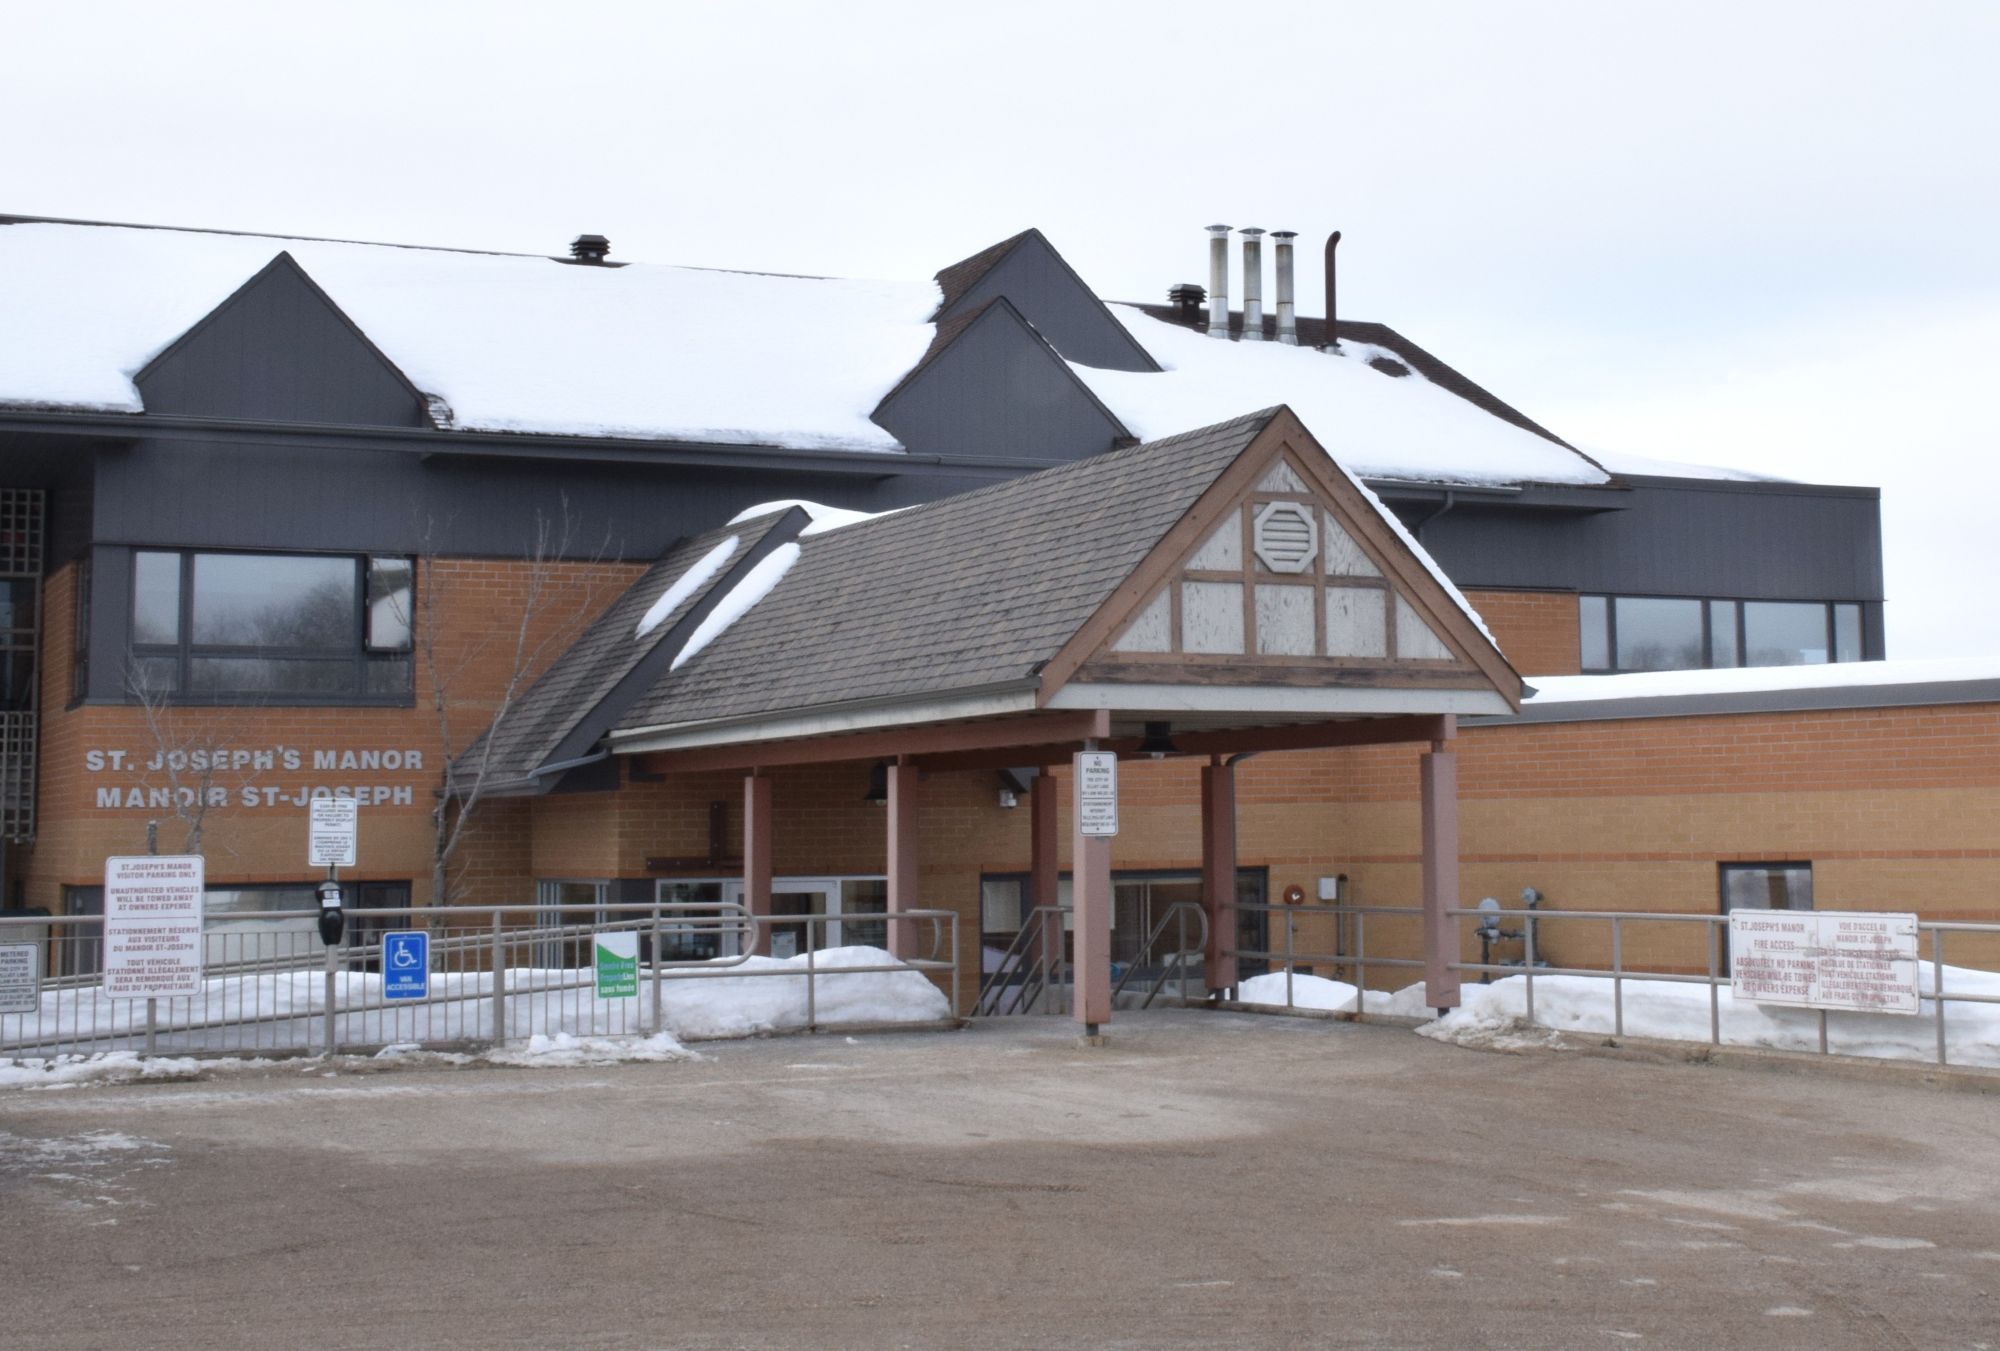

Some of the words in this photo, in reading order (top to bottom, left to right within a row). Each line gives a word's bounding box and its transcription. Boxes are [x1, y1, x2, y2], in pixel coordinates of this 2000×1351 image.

[86, 750, 134, 771] ST.
[147, 746, 301, 771] JOSEPH'S
[313, 750, 423, 770] MANOR
[96, 786, 229, 808] MANOIR
[1781, 923, 1804, 933] MANOR
[1754, 940, 1768, 949] FIRE
[1770, 940, 1795, 950] ACCESS
[1777, 959, 1785, 968] NO
[1787, 959, 1815, 970] PARKING
[1856, 960, 1891, 970] STATIONNER
[1794, 973, 1816, 982] TOWED
[1781, 985, 1809, 995] EXPENSE
